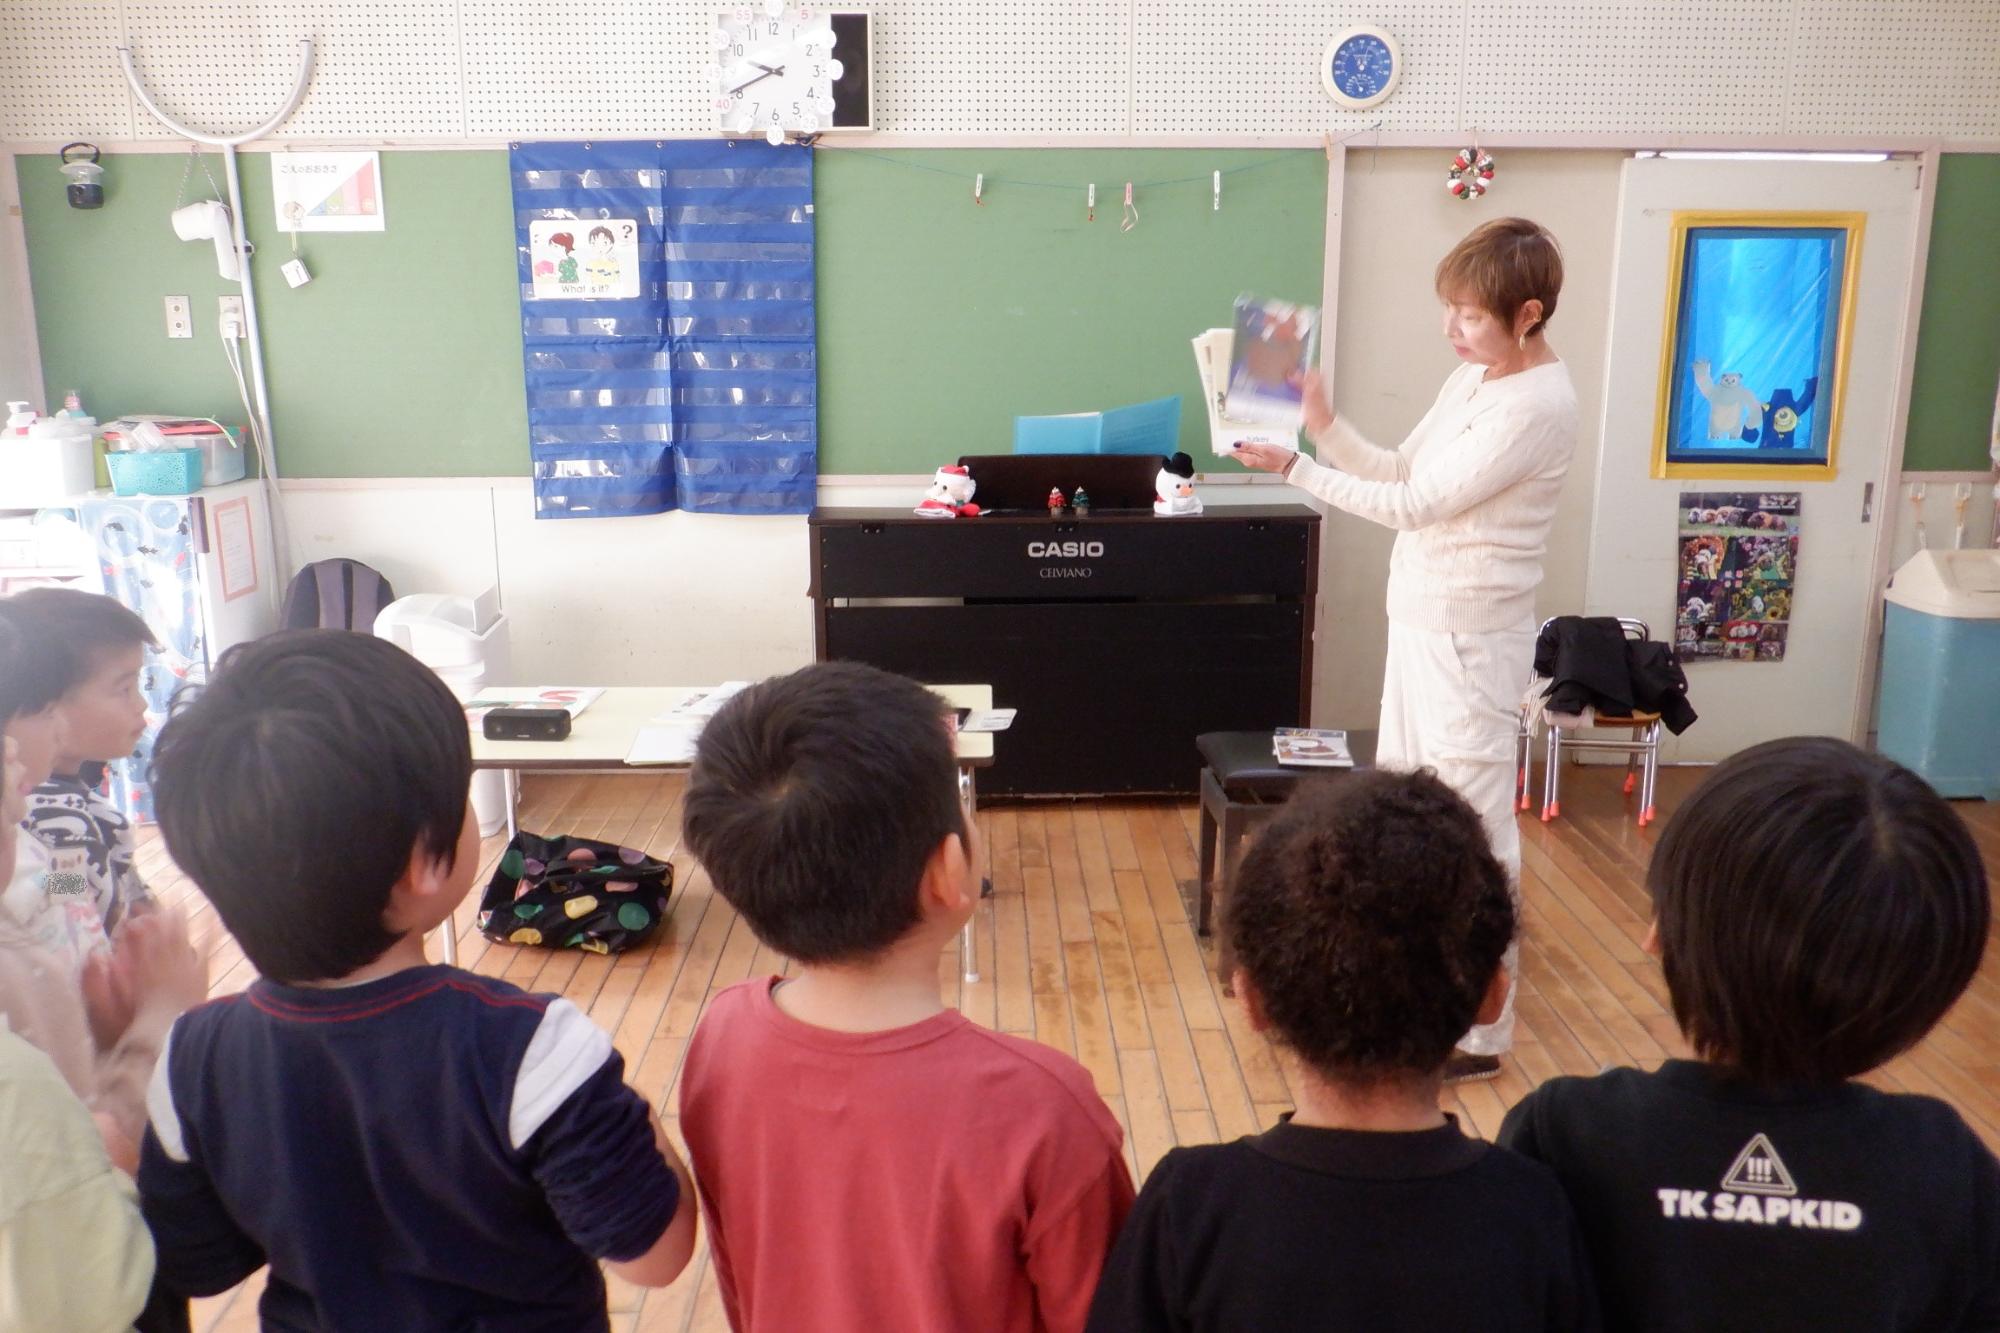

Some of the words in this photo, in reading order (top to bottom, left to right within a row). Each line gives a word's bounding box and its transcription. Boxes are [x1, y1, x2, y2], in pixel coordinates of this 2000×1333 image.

[736, 9, 751, 20] 55
[800, 9, 808, 20] 5
[746, 24, 758, 41] 11
[768, 22, 779, 36] 12
[714, 33, 728, 45] 50
[733, 44, 744, 57] 10
[806, 44, 813, 57] 2
[812, 65, 820, 78] 3
[806, 87, 815, 99] 4
[715, 99, 730, 109] 40
[752, 102, 760, 116] 7
[792, 102, 800, 116] 5
[771, 108, 780, 121] 6
[561, 284, 586, 294] What
[1027, 541, 1104, 558] CASIO
[1039, 567, 1092, 579] CELVIANO
[1657, 1188, 1708, 1218] TK
[1712, 1192, 1863, 1231] SAPKID
